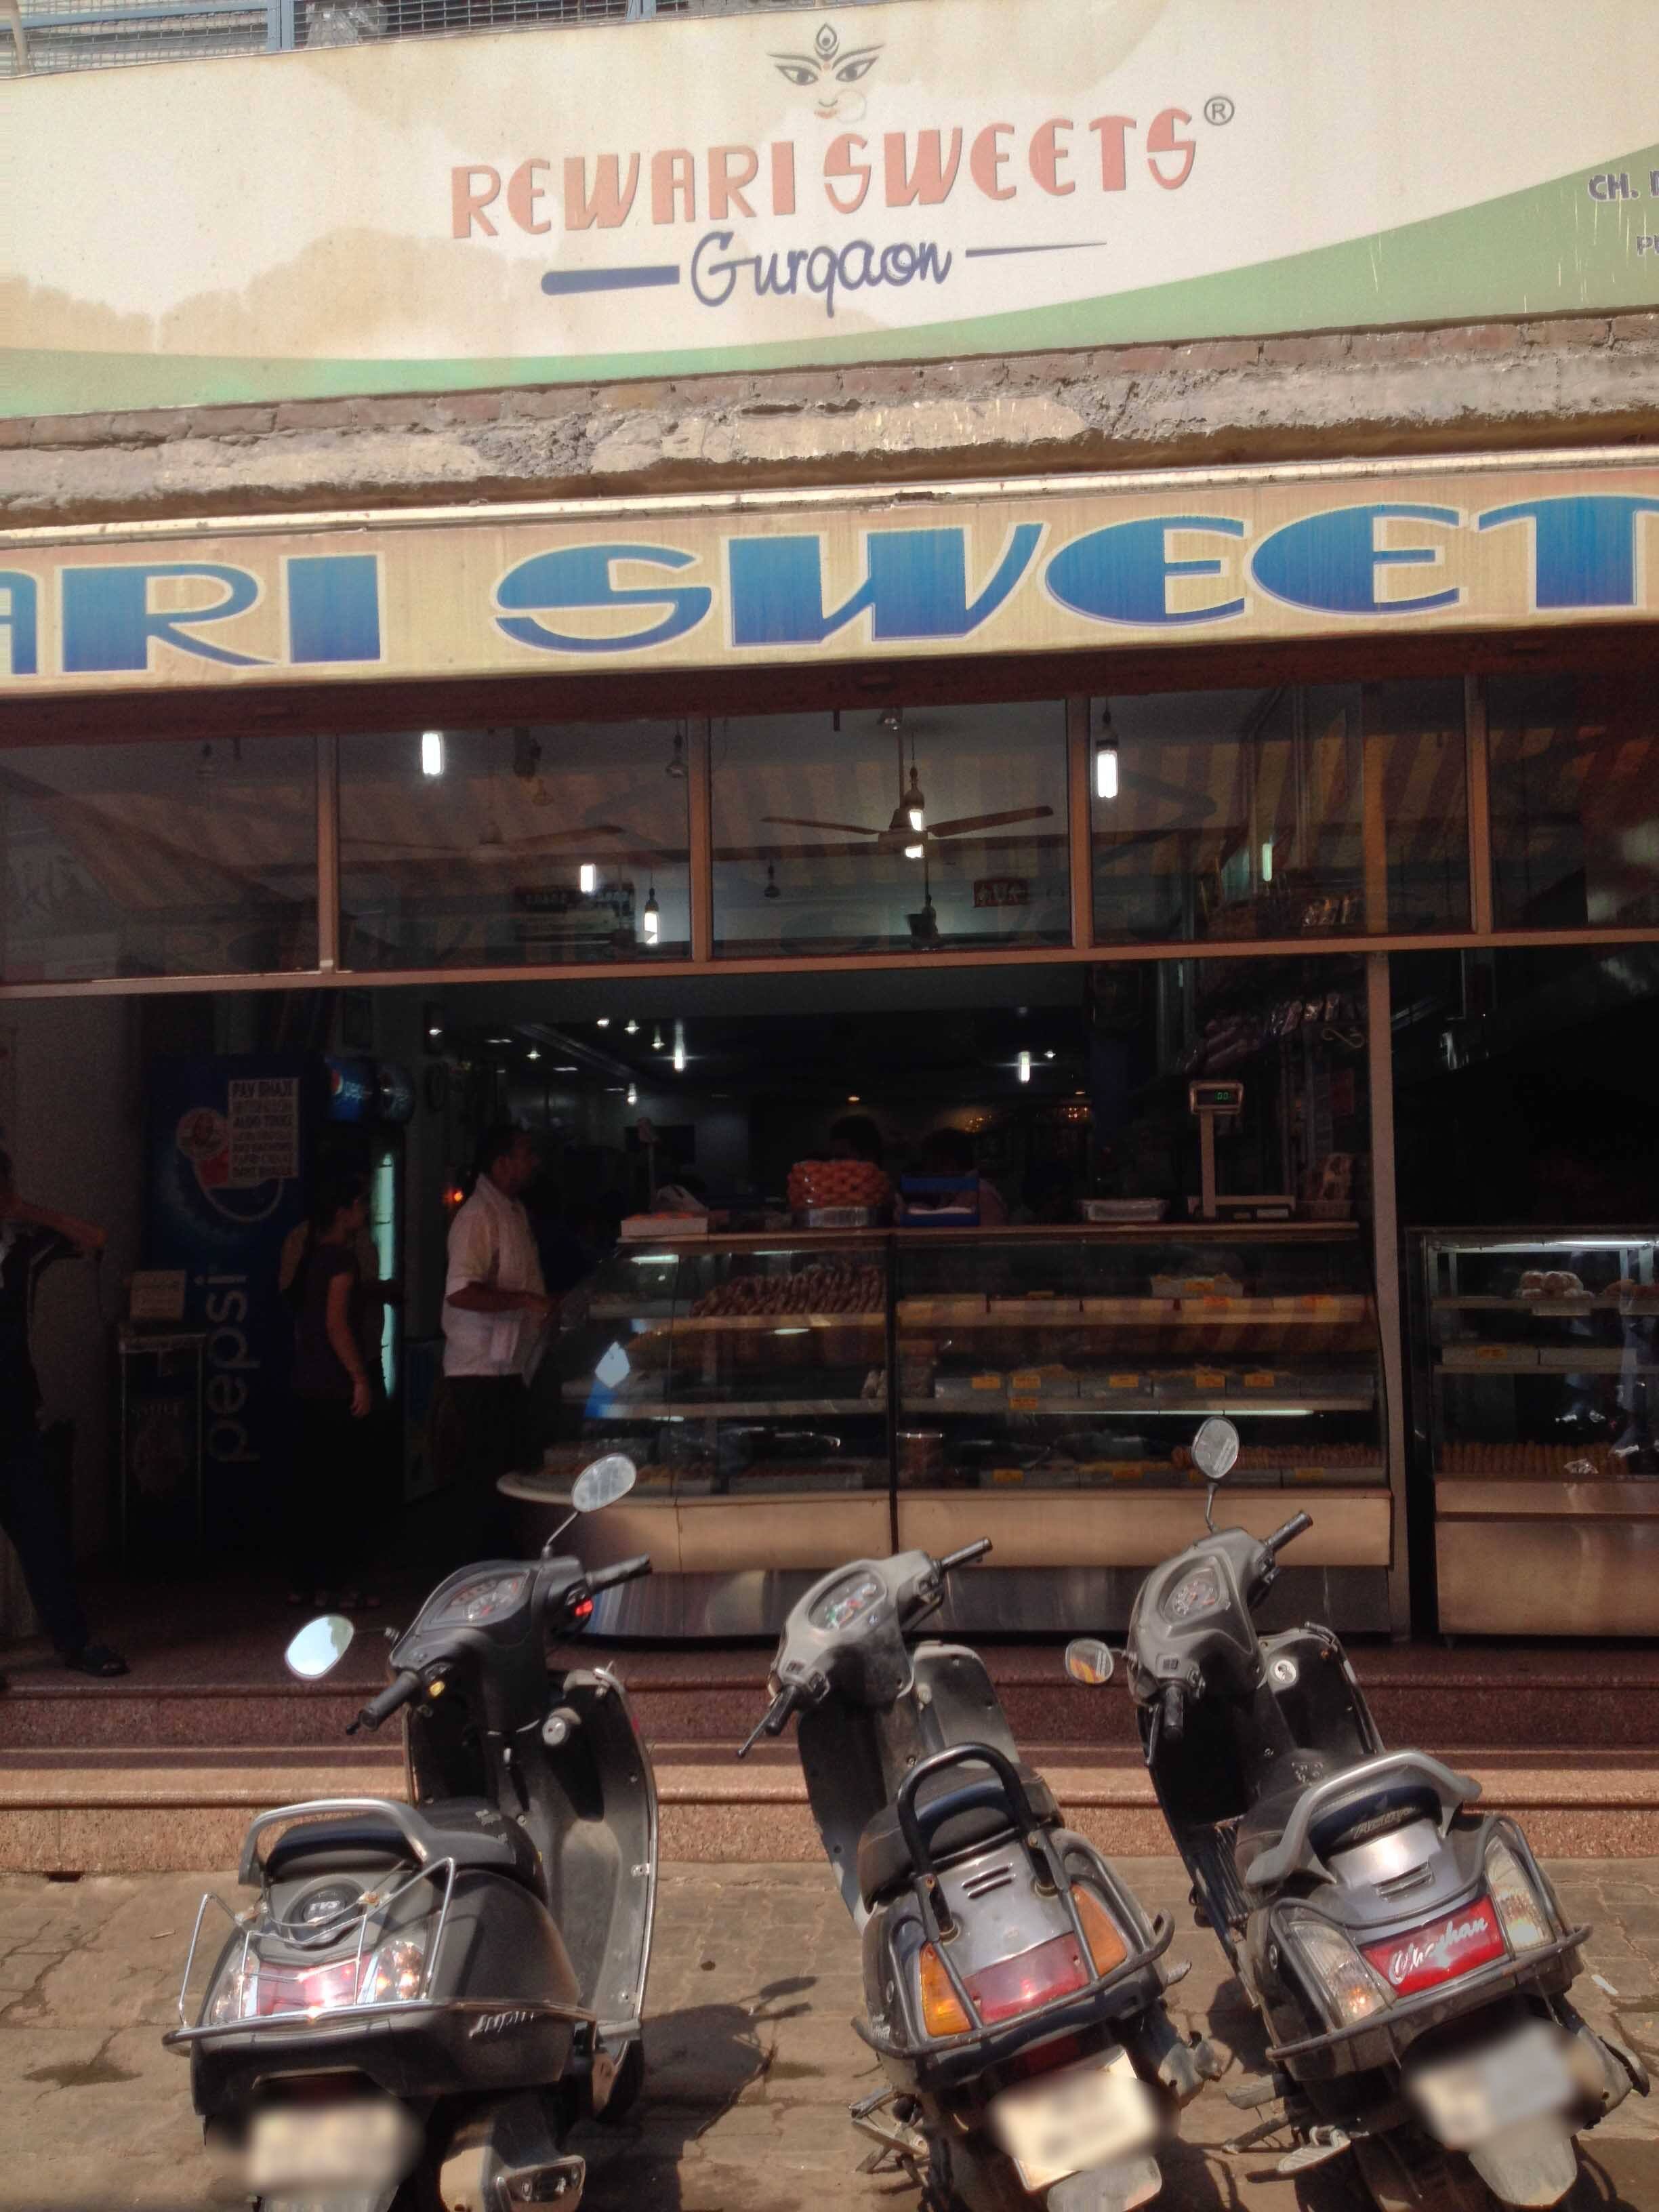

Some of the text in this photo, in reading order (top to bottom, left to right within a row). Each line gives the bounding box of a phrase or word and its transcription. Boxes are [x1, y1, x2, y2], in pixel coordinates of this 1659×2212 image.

[451, 141, 796, 239] REWARI
[823, 107, 1196, 214] SWEETS
[0, 554, 380, 676] RI
[194, 1274, 261, 1464] pepsi
